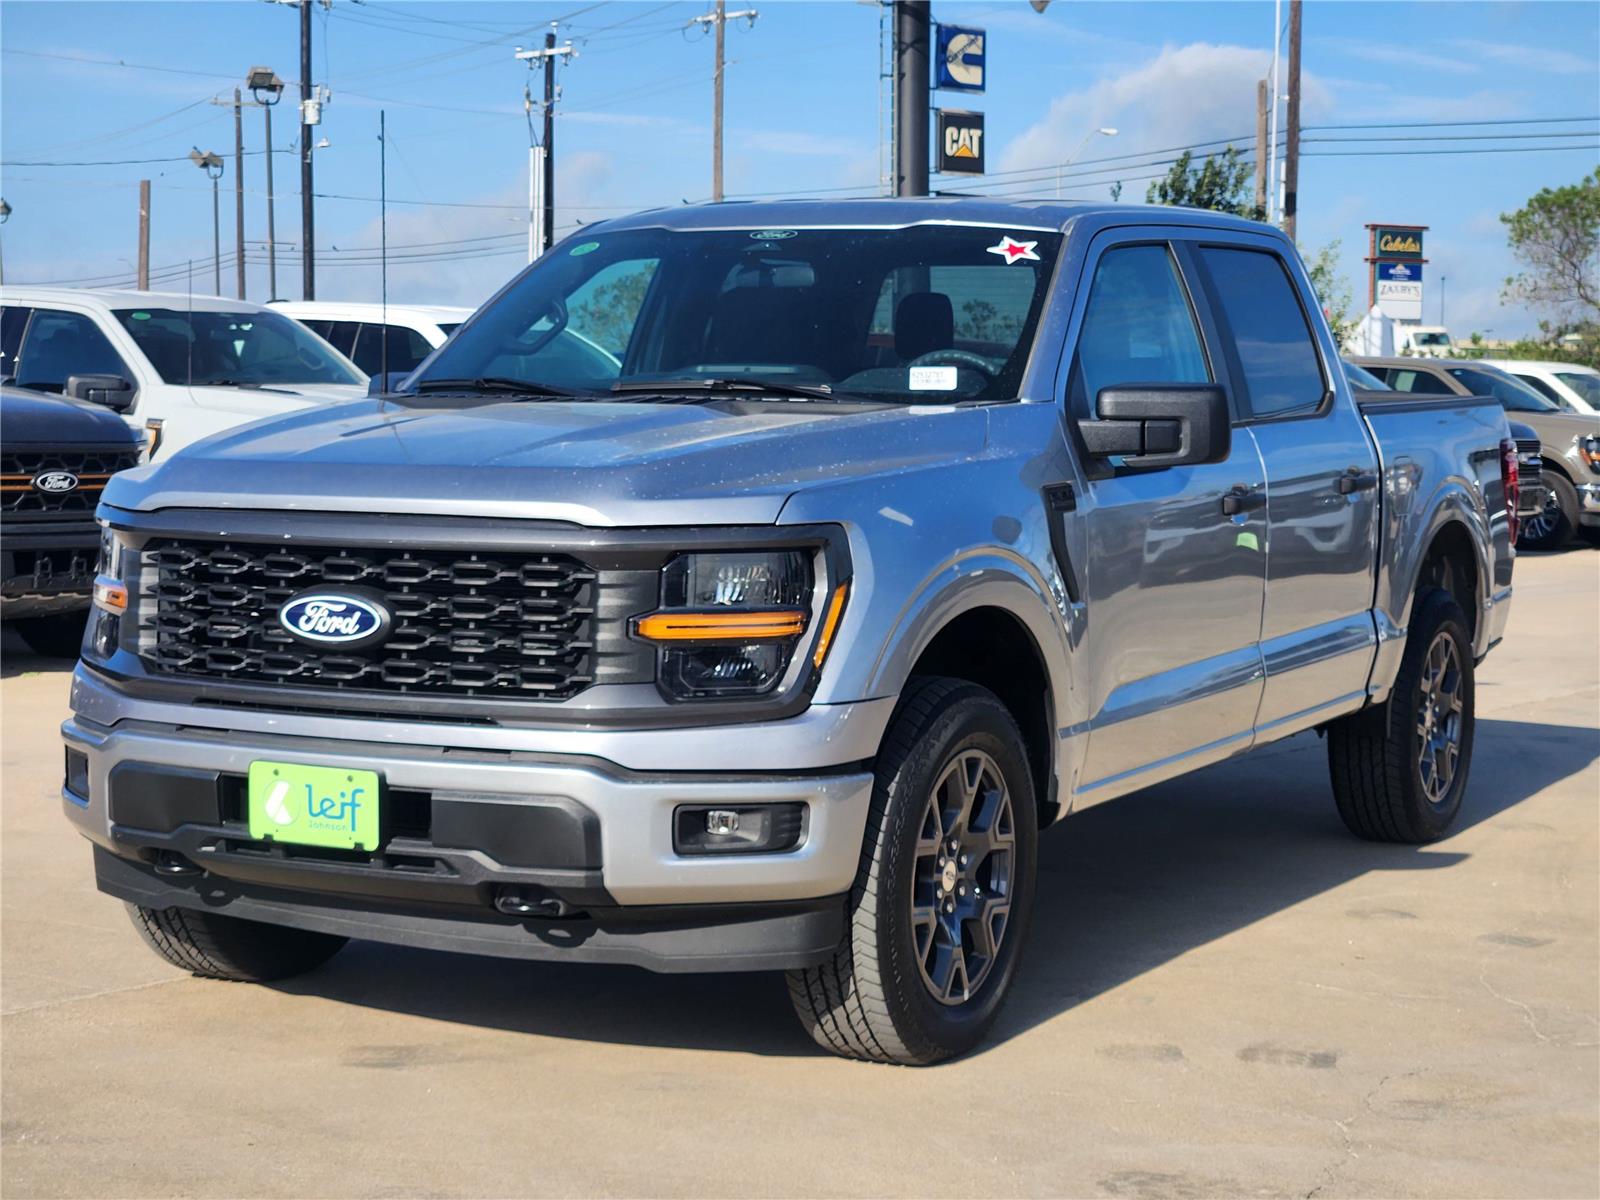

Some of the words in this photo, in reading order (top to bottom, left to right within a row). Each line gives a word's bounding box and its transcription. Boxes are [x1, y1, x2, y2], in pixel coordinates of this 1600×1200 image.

[945, 126, 982, 158] CAT
[44, 475, 71, 489] Ford
[299, 601, 361, 634] Ford
[308, 820, 348, 832] Johnson
